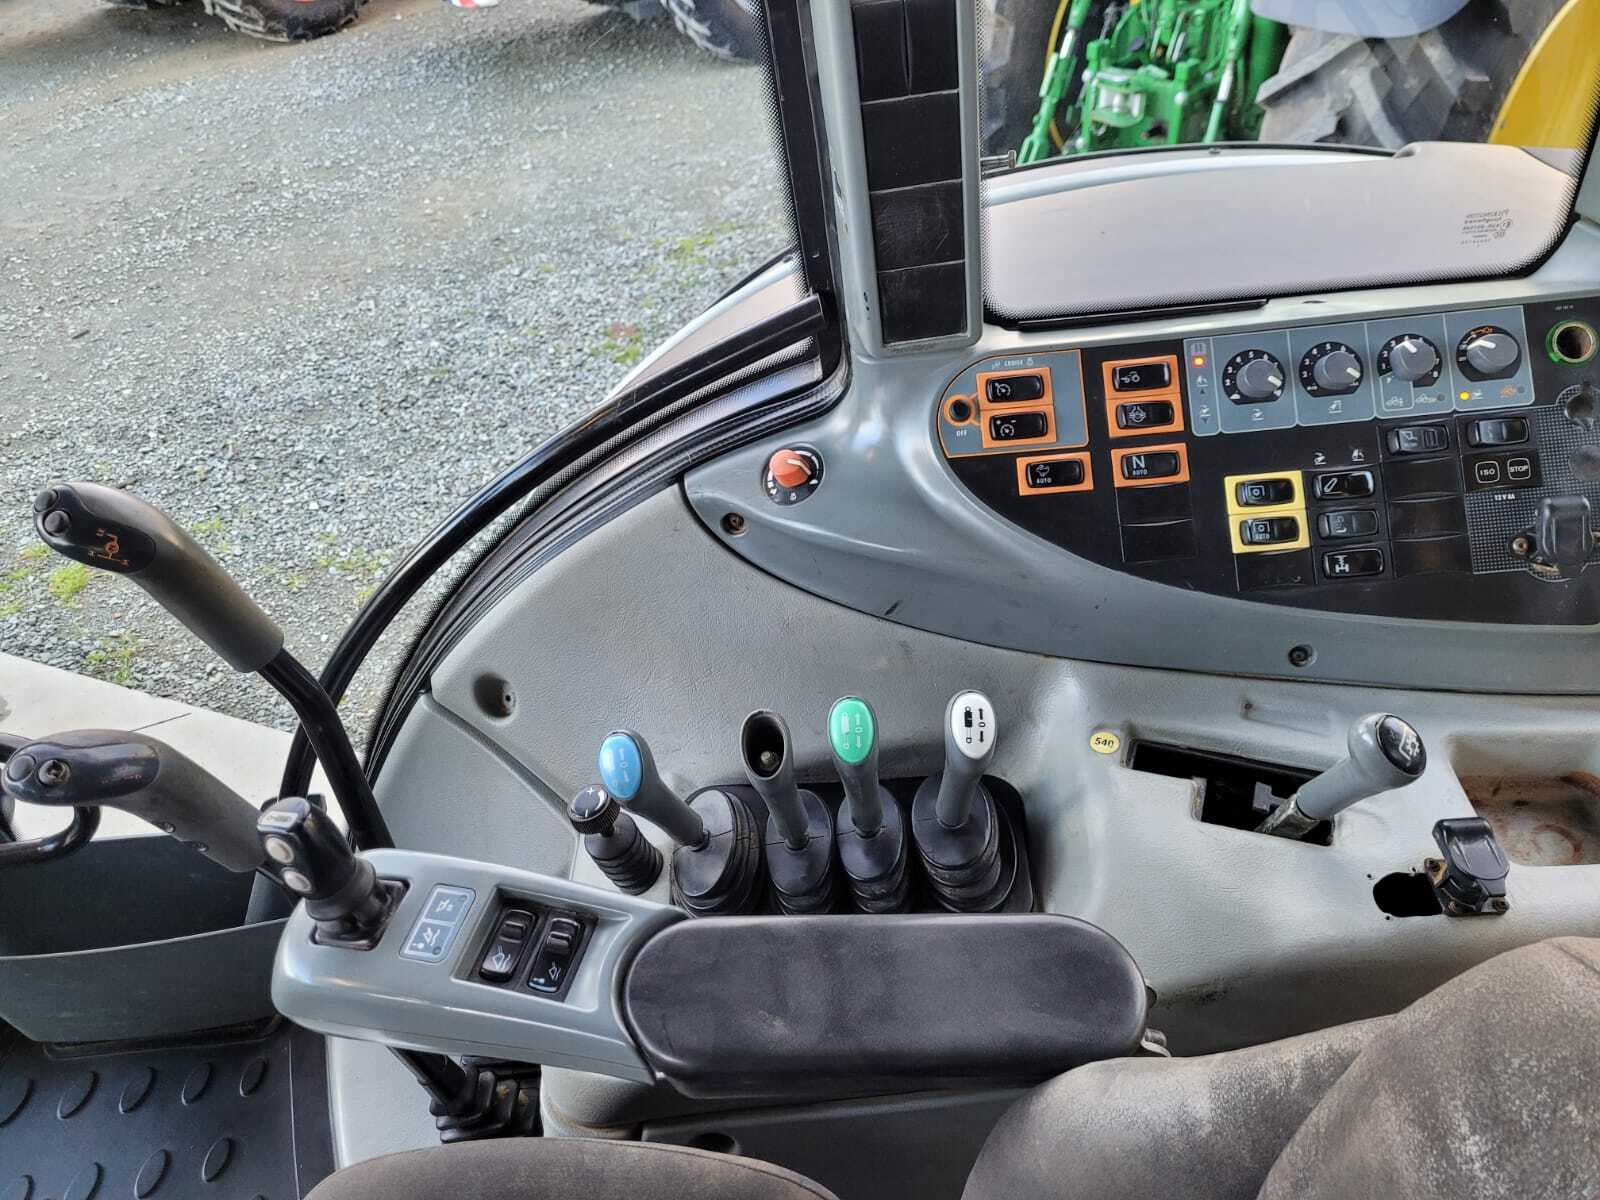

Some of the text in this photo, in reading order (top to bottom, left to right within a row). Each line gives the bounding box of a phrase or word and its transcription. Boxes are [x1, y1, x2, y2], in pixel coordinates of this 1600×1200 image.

[956, 429, 968, 437] OFF
[1132, 455, 1146, 469] N
[1132, 468, 1148, 476] AUTO
[1480, 468, 1496, 476] ISO
[1510, 465, 1529, 473] STOP
[1094, 736, 1114, 748] 540
